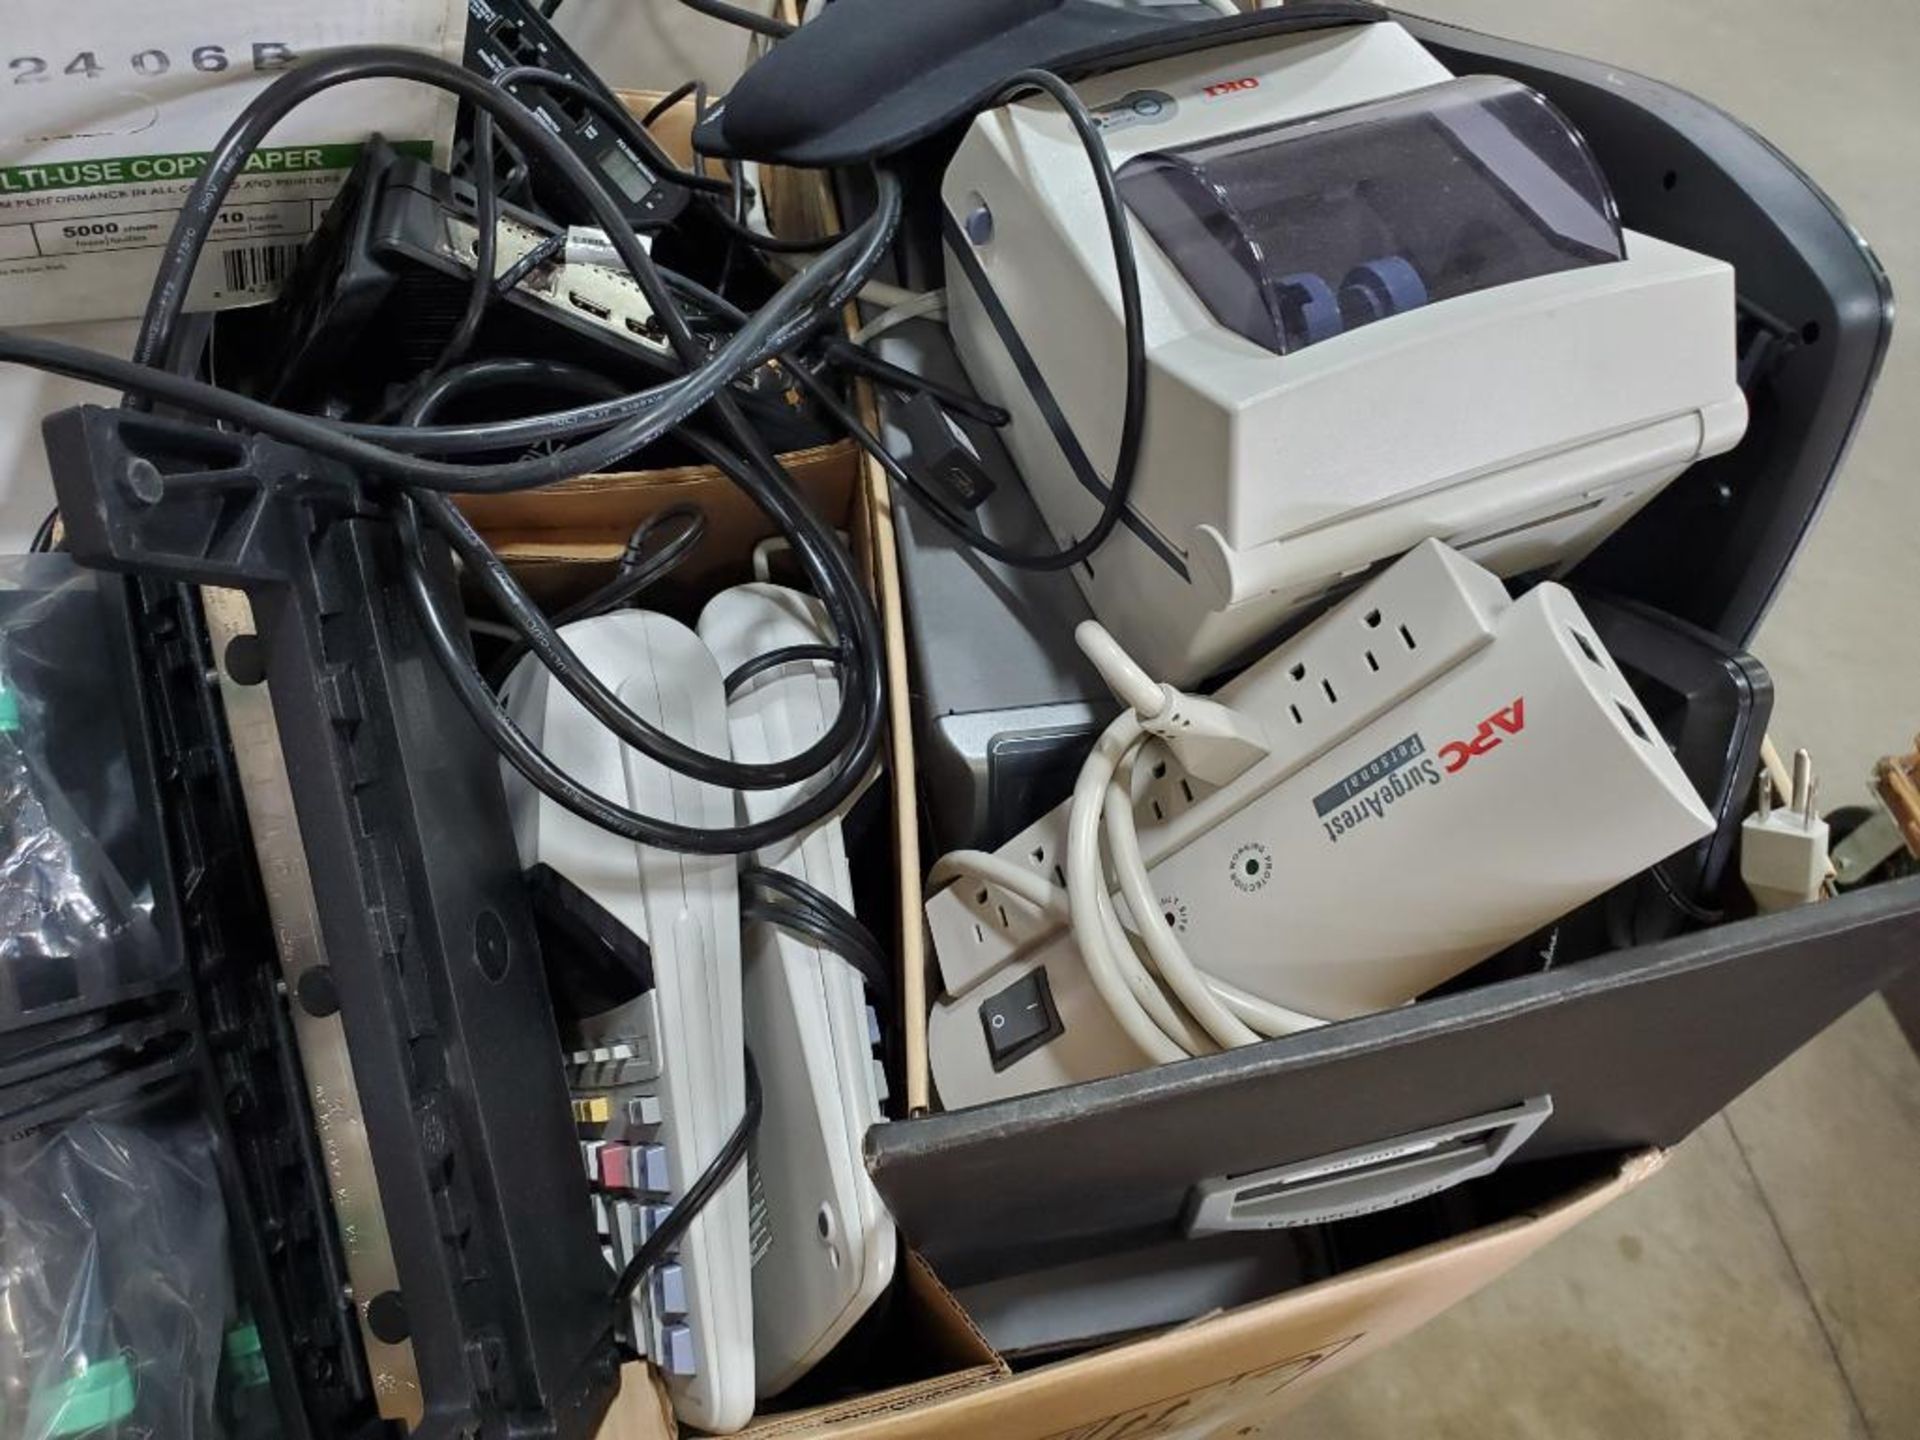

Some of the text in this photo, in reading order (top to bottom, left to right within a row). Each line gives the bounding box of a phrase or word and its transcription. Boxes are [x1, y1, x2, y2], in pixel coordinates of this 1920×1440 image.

[1203, 78, 1259, 97] OKI
[131, 156, 208, 178] COP
[243, 148, 323, 171] APER
[219, 212, 244, 223] 10
[63, 222, 118, 238] 5000
[1323, 697, 1524, 842] APC SurgeArrest
[1343, 736, 1424, 797] Personal
